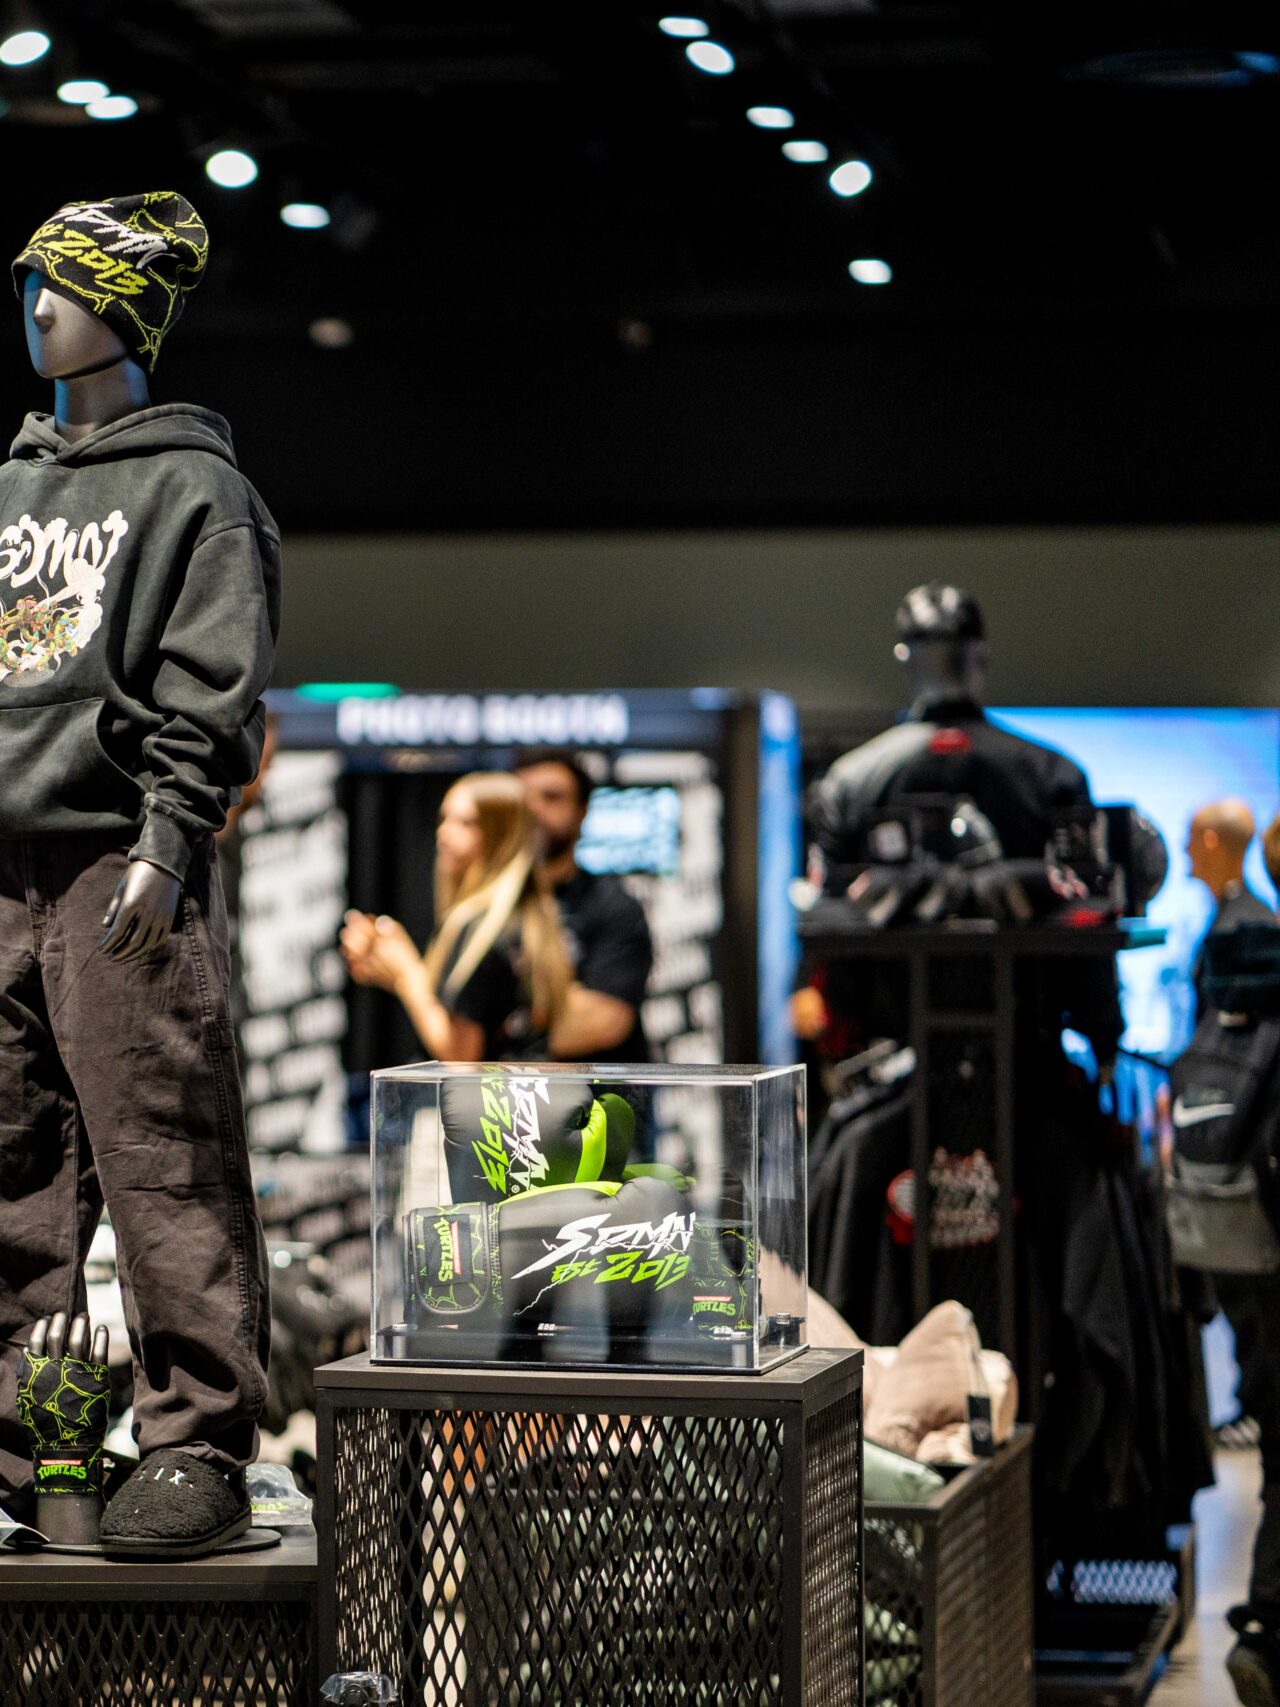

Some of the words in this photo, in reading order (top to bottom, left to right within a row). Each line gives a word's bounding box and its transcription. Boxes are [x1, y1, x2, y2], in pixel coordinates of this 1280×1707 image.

[432, 1216, 455, 1282] TURTLES
[593, 1250, 692, 1292] 2013
[36, 1464, 87, 1480] TURTLES
